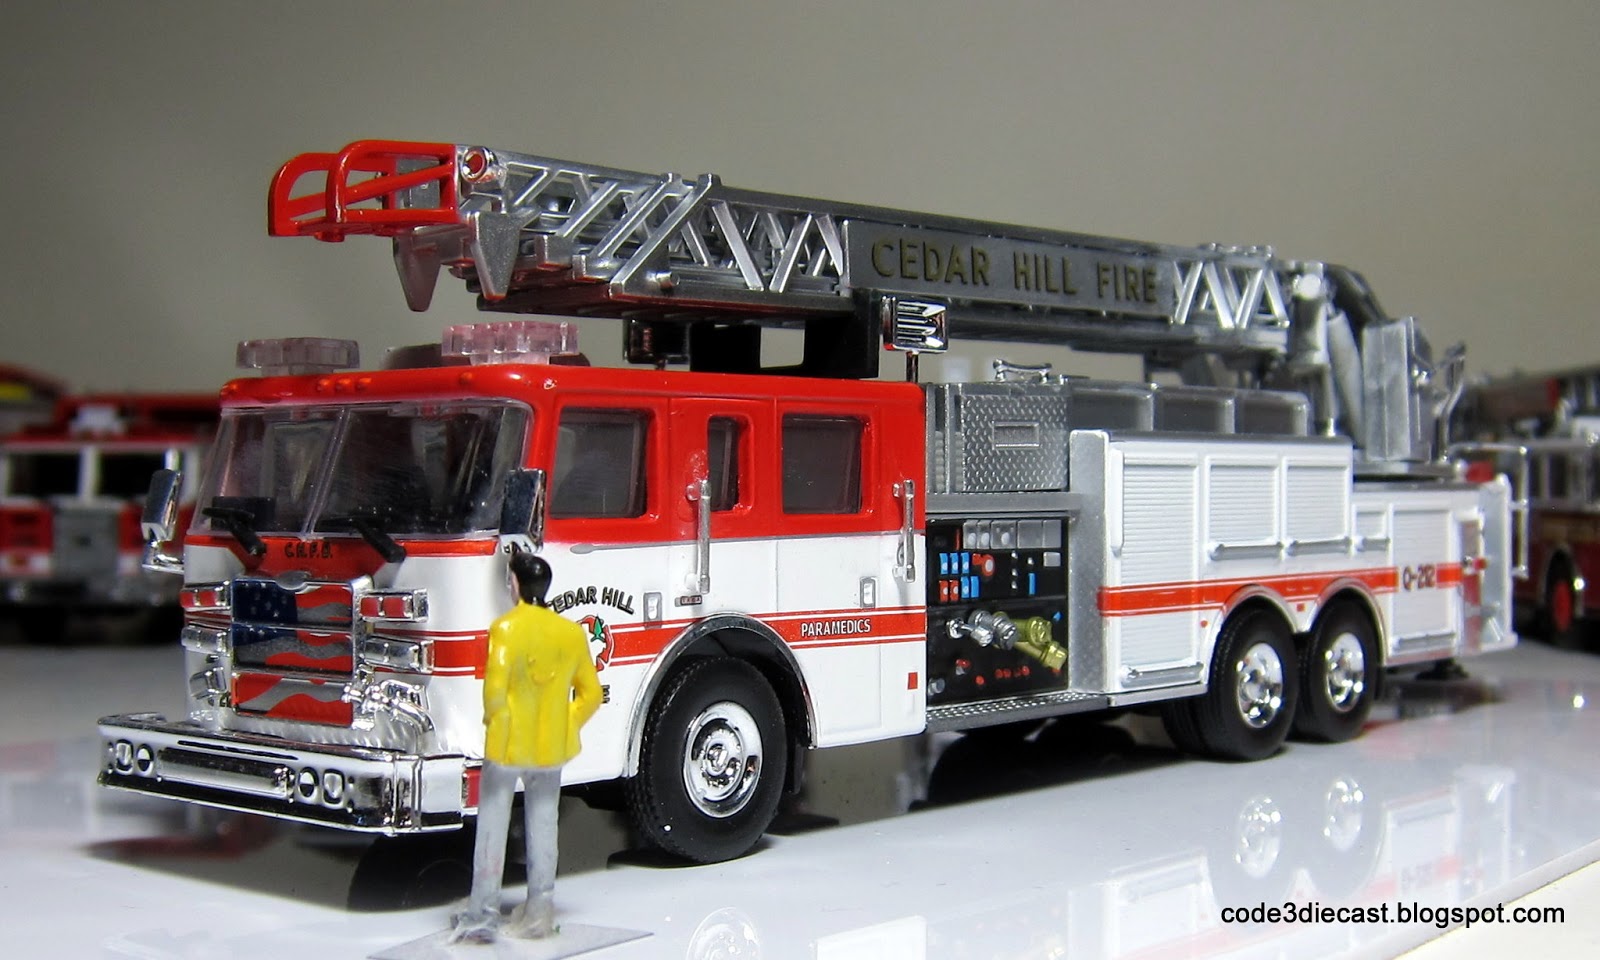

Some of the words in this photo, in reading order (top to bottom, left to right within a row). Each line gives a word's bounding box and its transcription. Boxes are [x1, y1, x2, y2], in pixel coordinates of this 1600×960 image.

[871, 238, 990, 286] CEDAR
[1012, 251, 1079, 295] HILL
[1096, 260, 1158, 304] FIRE
[547, 586, 597, 614] EDAR
[601, 586, 635, 615] HILL
[801, 619, 872, 637] PARAMEDICS
